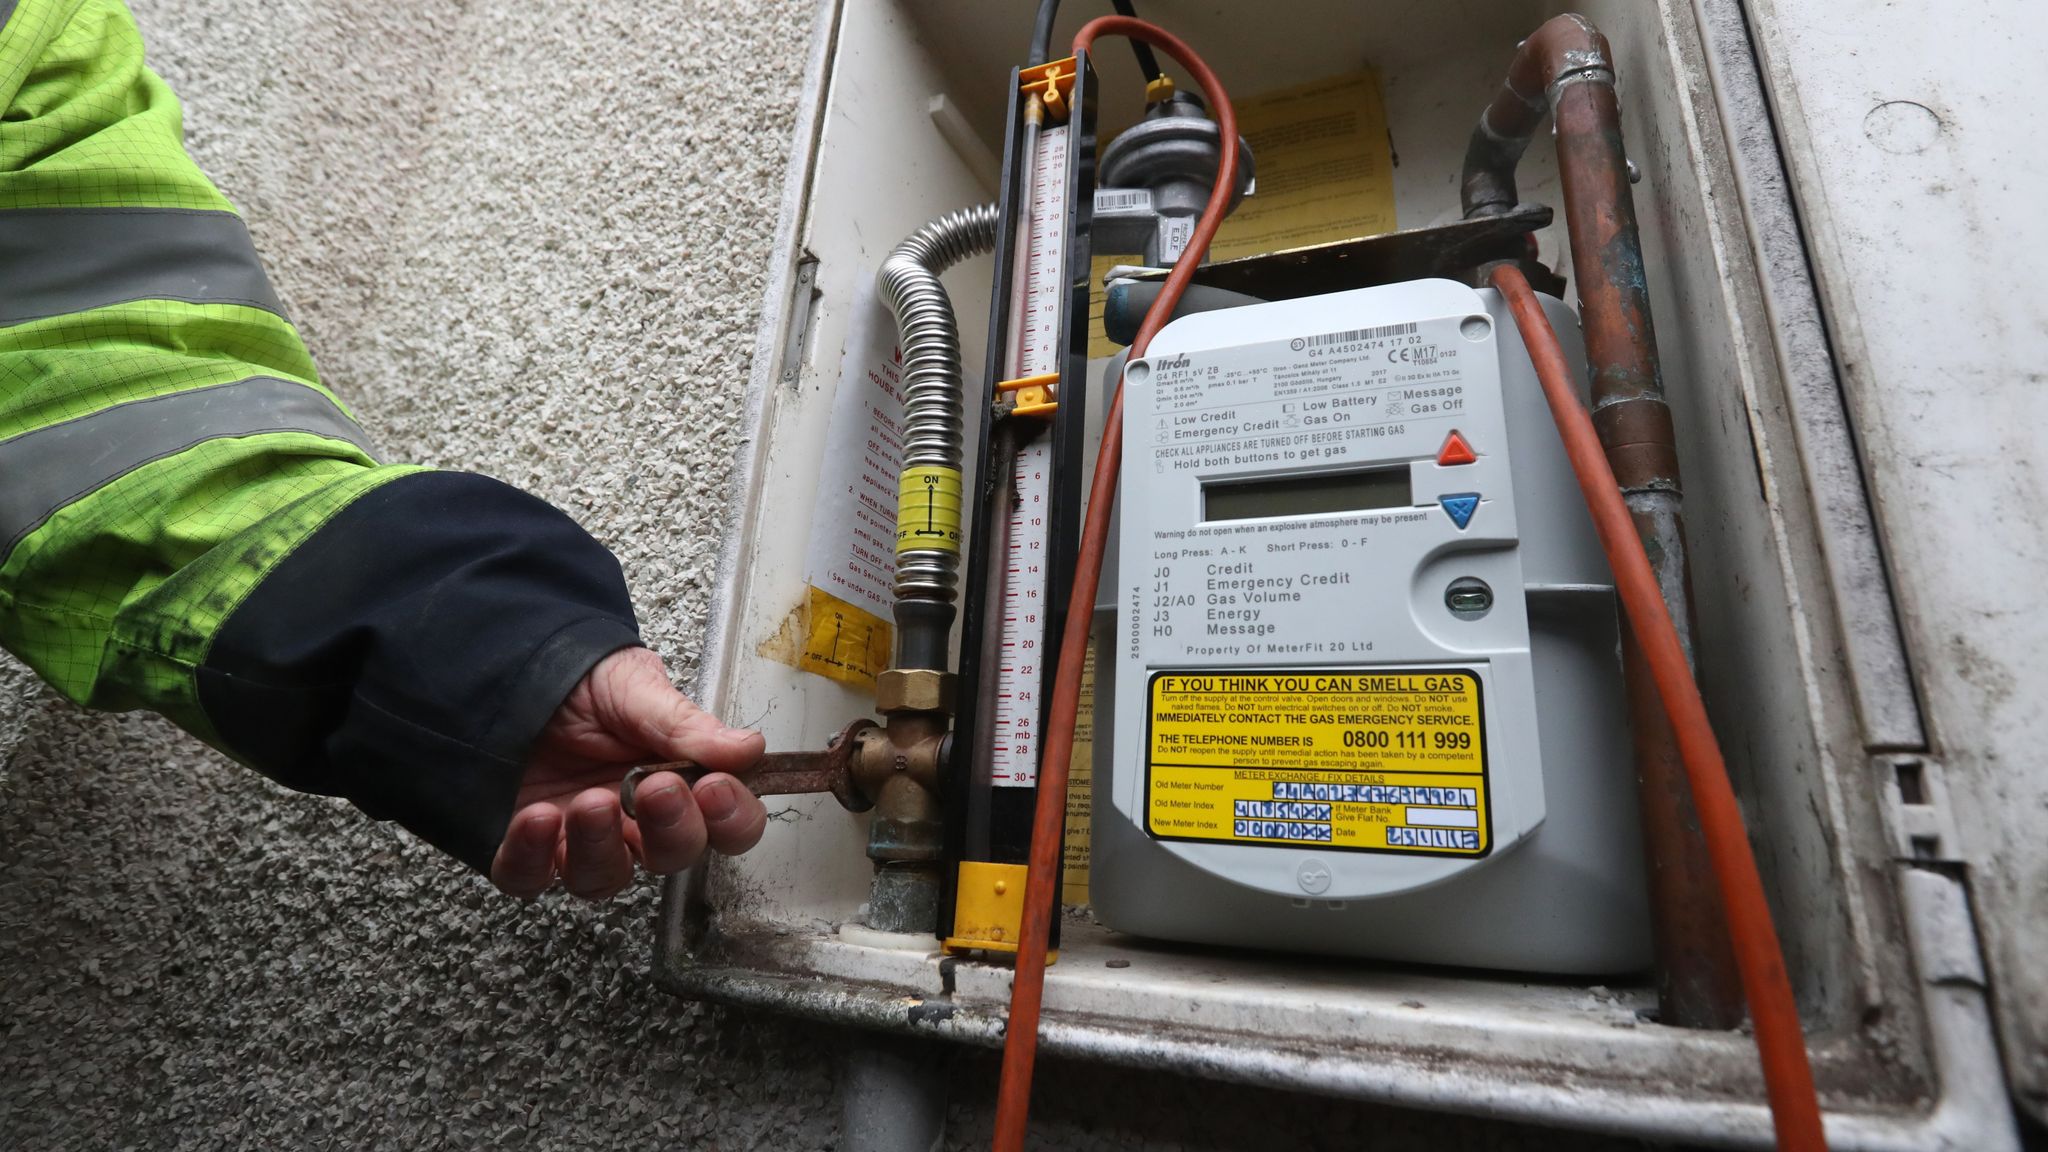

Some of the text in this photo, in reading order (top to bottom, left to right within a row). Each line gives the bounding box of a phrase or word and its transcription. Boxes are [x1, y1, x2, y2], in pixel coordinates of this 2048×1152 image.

[1309, 335, 1422, 357] G4 A4502474 17 02
[1414, 346, 1435, 359] M17
[882, 363, 900, 384] THIS
[868, 370, 894, 396] HOUSE
[1404, 386, 1462, 399] Message
[1303, 394, 1378, 411] Low Battery
[1411, 399, 1463, 414] Gas Off
[873, 407, 895, 428] BEFORE
[1174, 411, 1236, 426] Low Credit
[1304, 412, 1351, 425] Gas On
[1174, 420, 1279, 439] Emergency Credit
[1156, 425, 1405, 458] CHECK ALL APPLIANCES ARE TURNED OFF BEFORE STARTING GAS
[1174, 445, 1347, 469] Hold both buttons to get gas
[924, 476, 939, 484] ON
[860, 492, 878, 509] WHEN
[1030, 518, 1041, 526] 10
[1154, 530, 1185, 539] Warning
[1188, 528, 1197, 537] do
[1199, 528, 1211, 536] not
[1214, 527, 1232, 536] open
[1235, 525, 1255, 534] when
[1270, 521, 1307, 532] explosive
[1310, 518, 1358, 529] atmosphere
[1361, 516, 1379, 526] may
[1382, 514, 1392, 524] be
[1395, 513, 1428, 524] present
[1267, 540, 1333, 552] Short Press:
[852, 544, 882, 565] TURN OFF
[1154, 549, 1213, 560] Long Press:
[849, 562, 886, 587] Gas Service
[1154, 563, 1253, 578] J0 Credit
[832, 573, 880, 602] See under GAS
[1154, 572, 1350, 592] J1 Emergency Credit
[1026, 590, 1037, 598] 16
[1207, 594, 1236, 605] Gas
[1244, 591, 1301, 603] Volume
[1025, 615, 1036, 623] 18
[1154, 608, 1260, 622] J3 Energy
[1154, 624, 1275, 637] H0 Message
[1186, 642, 1373, 656] Property Of MeterFit 20 Ltd
[1021, 666, 1032, 674] 22
[1162, 677, 1464, 691] IF YOU THINK YOU CAN SMELL GAS
[1019, 692, 1030, 700] 24
[1018, 719, 1029, 727] 26
[1156, 713, 1474, 726] IMMEDIATELY CONTACT THE GAS EMERGENCY SERVICE.
[1015, 731, 1030, 739] mb
[1159, 731, 1471, 749] THE TELEPHONE NUMBER IS 0800 111 999
[1016, 746, 1028, 754] 28
[1272, 758, 1301, 766] prevent
[1320, 760, 1357, 768] escaping
[1014, 773, 1026, 781] 30
[1234, 771, 1384, 783] METER EXCHANGE FIX DETAILS
[1170, 782, 1192, 790] Meter
[1194, 783, 1224, 791] Number
[1155, 800, 1214, 810] Old Meter Index
[1344, 805, 1367, 813] Meter
[1370, 806, 1392, 814] Bank
[1154, 818, 1218, 829] New Meter Index
[1336, 813, 1390, 823] Give Flat No.
[1336, 828, 1356, 837] Date
